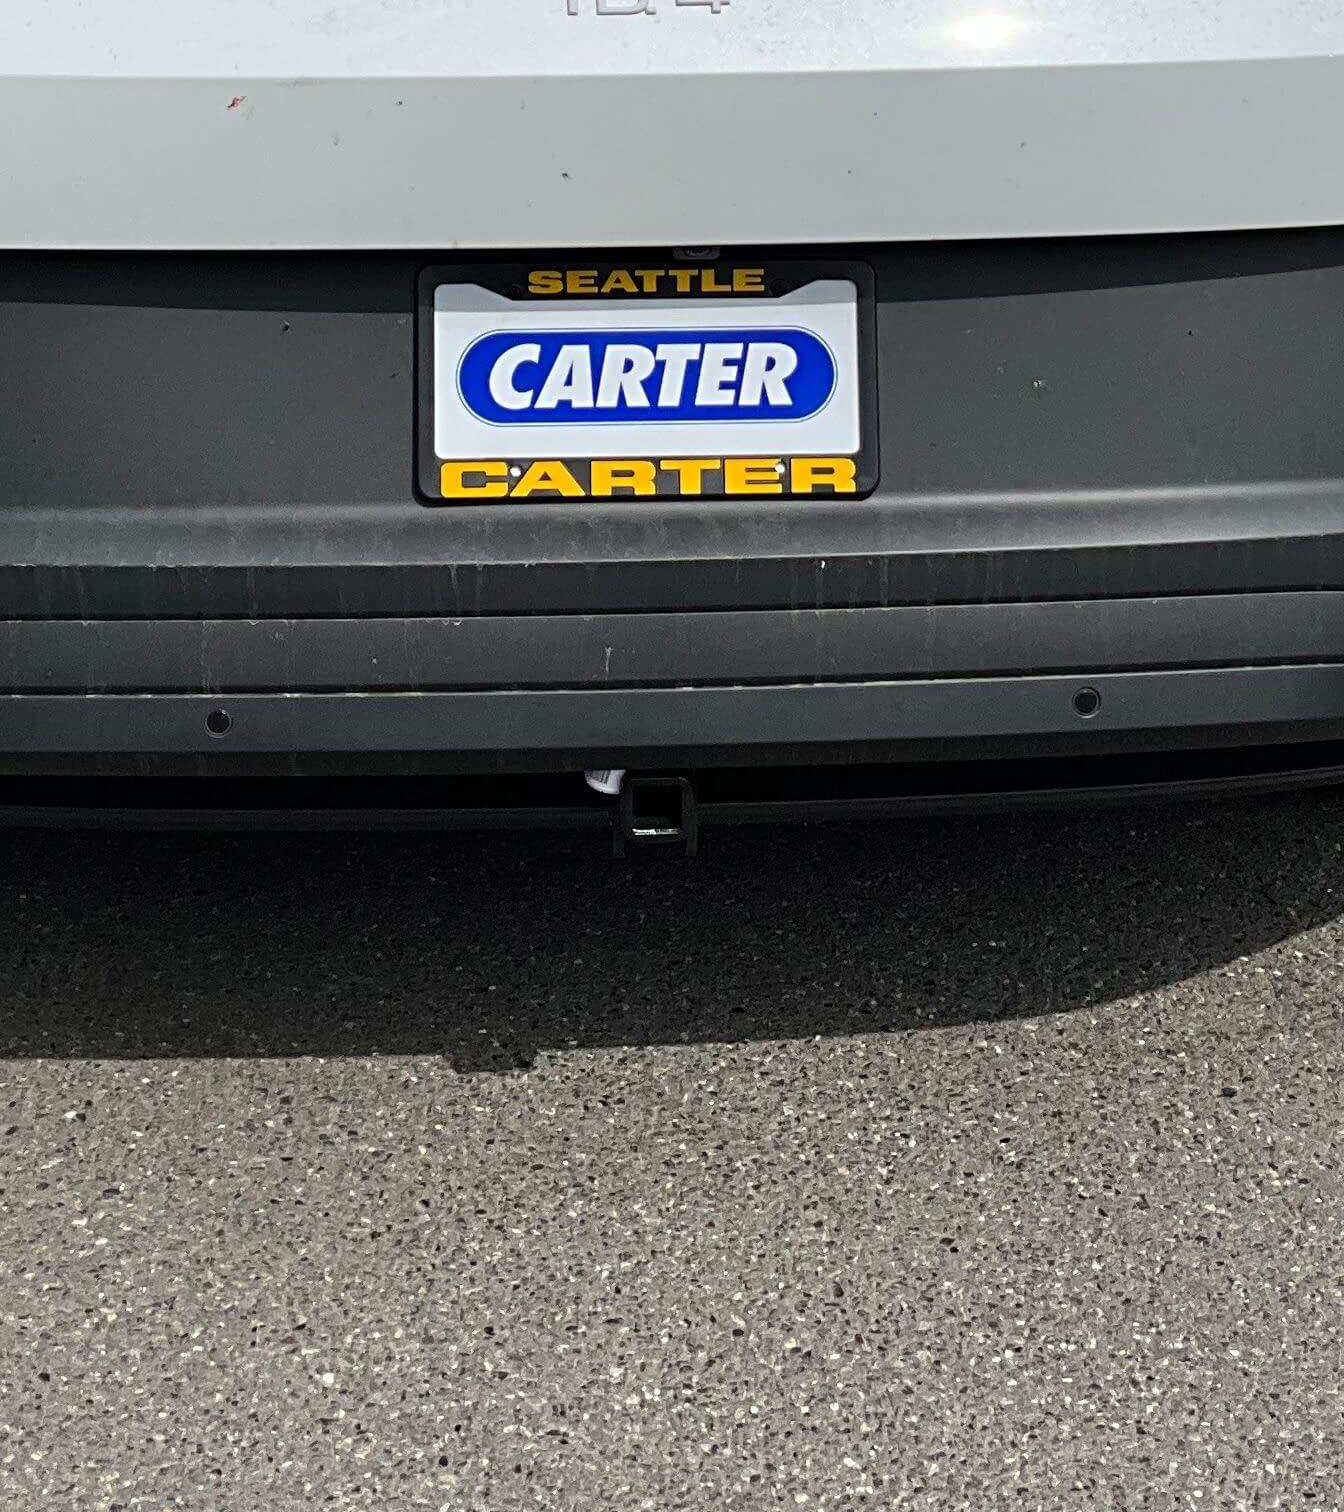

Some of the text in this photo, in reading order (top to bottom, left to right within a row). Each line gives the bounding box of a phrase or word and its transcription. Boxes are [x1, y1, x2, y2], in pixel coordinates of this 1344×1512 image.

[527, 268, 765, 295] SEATTLE
[488, 342, 799, 411] CARTER
[439, 456, 857, 499] CARTER
